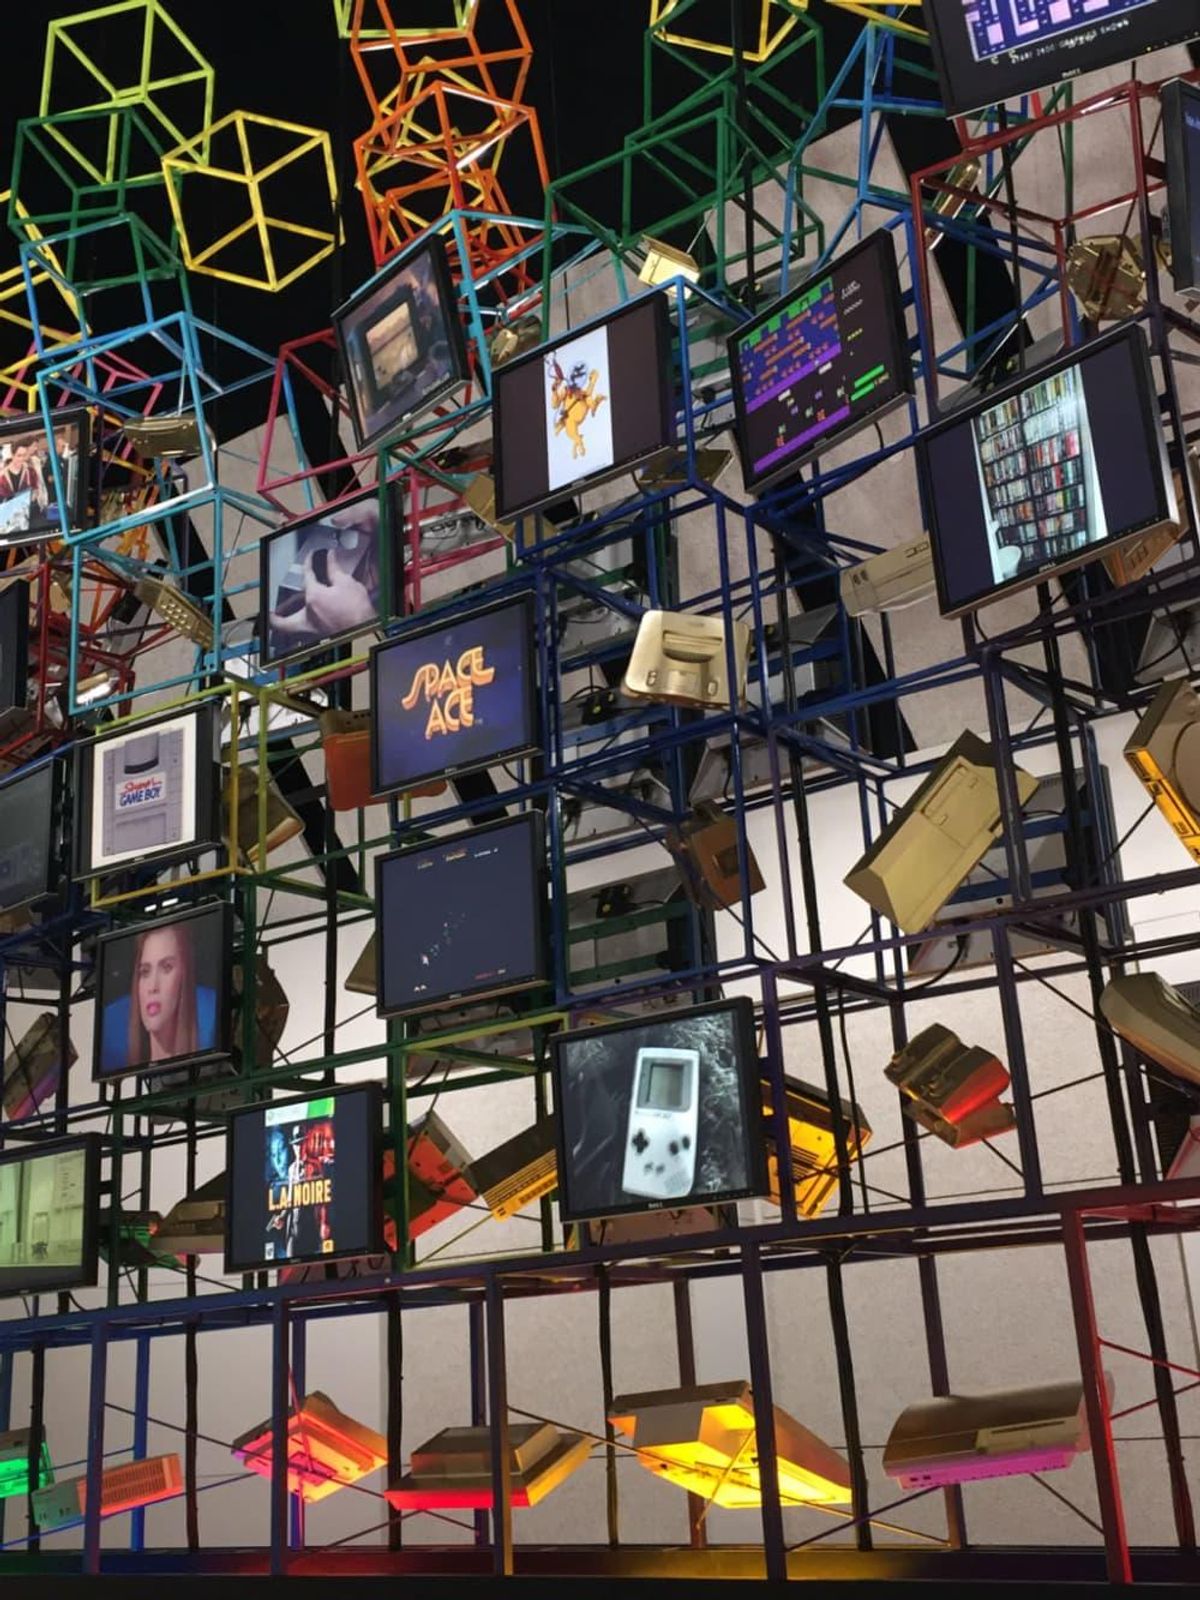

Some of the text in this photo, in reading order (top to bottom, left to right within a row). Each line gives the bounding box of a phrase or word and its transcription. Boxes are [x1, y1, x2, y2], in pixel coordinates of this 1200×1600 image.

[401, 645, 497, 711] SPACE
[424, 685, 476, 740] ACE
[119, 787, 161, 808] GAME BOY
[293, 1179, 333, 1208] NOIRE
